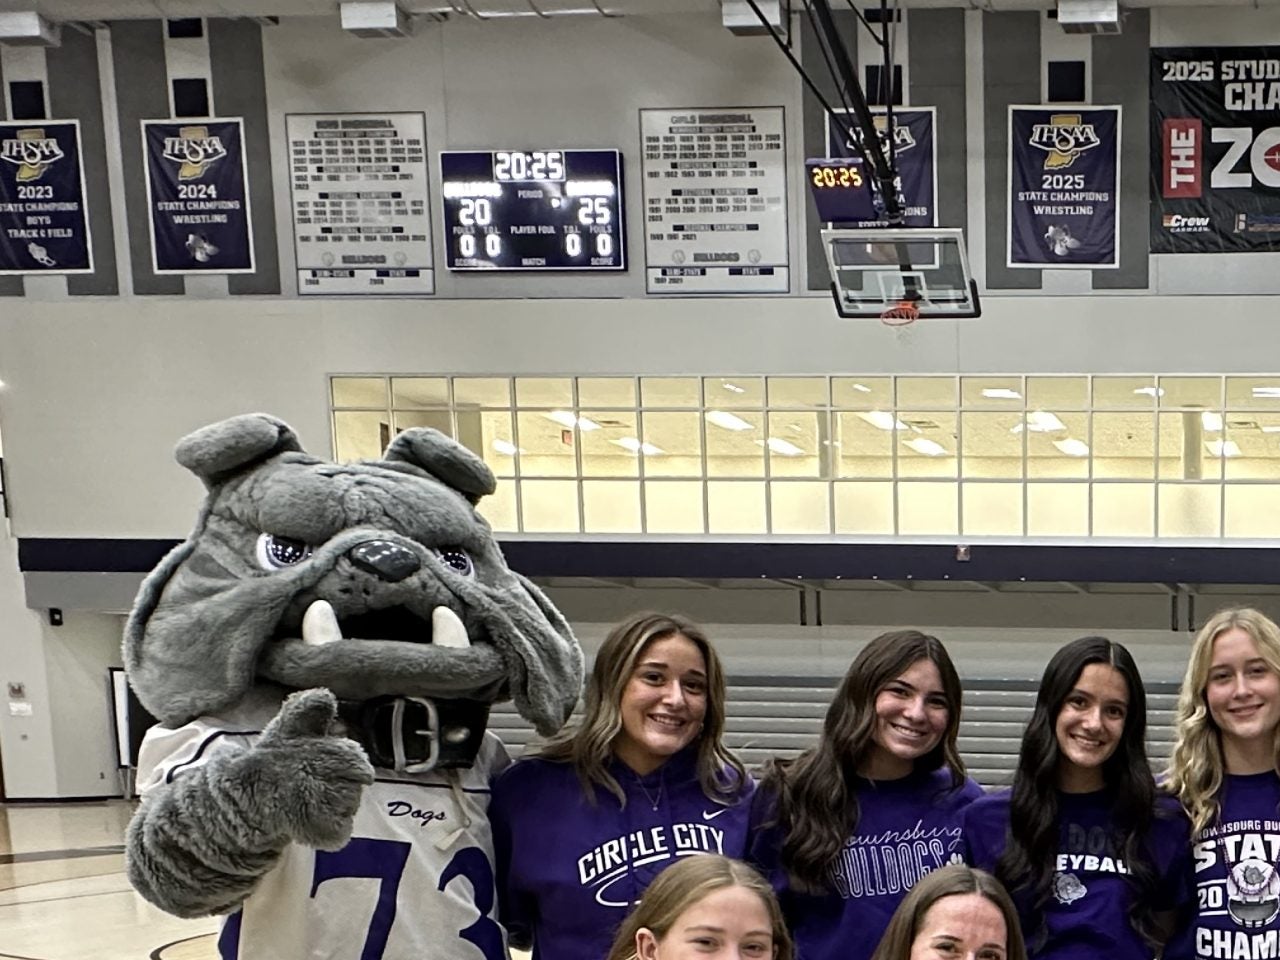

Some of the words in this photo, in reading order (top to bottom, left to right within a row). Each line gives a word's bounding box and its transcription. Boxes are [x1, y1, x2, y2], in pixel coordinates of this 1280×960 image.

[1162, 61, 1214, 81] 2025
[1029, 125, 1100, 152] IHSAA
[1, 139, 64, 164] IHSAA
[163, 137, 226, 164] IHSAA
[1170, 128, 1195, 189] THE
[496, 152, 563, 179] 20:25
[812, 167, 862, 187] 20:25
[1042, 175, 1085, 189] 2025
[17, 186, 54, 199] 2023
[178, 185, 217, 198] 2024
[1018, 191, 1049, 201] STATE
[1050, 191, 1109, 202] CHAMPIONS
[25, 202, 78, 211] CHAMPIONS
[158, 201, 186, 211] STATE
[187, 200, 240, 210] CHAMPIONS
[459, 199, 491, 225] 20
[578, 198, 610, 225] 25
[1033, 205, 1093, 215] WRESTLING
[172, 214, 228, 224] WRESTLING
[1171, 214, 1210, 227] Crew
[8, 229, 38, 238] TRACK
[47, 228, 73, 238] FIELD
[511, 226, 536, 235] PLAYER
[460, 234, 475, 257] 0
[486, 234, 501, 257] 0
[566, 234, 581, 257] 0
[597, 233, 612, 256] 0
[387, 801, 448, 826] Dogs
[1197, 885, 1223, 908] 20
